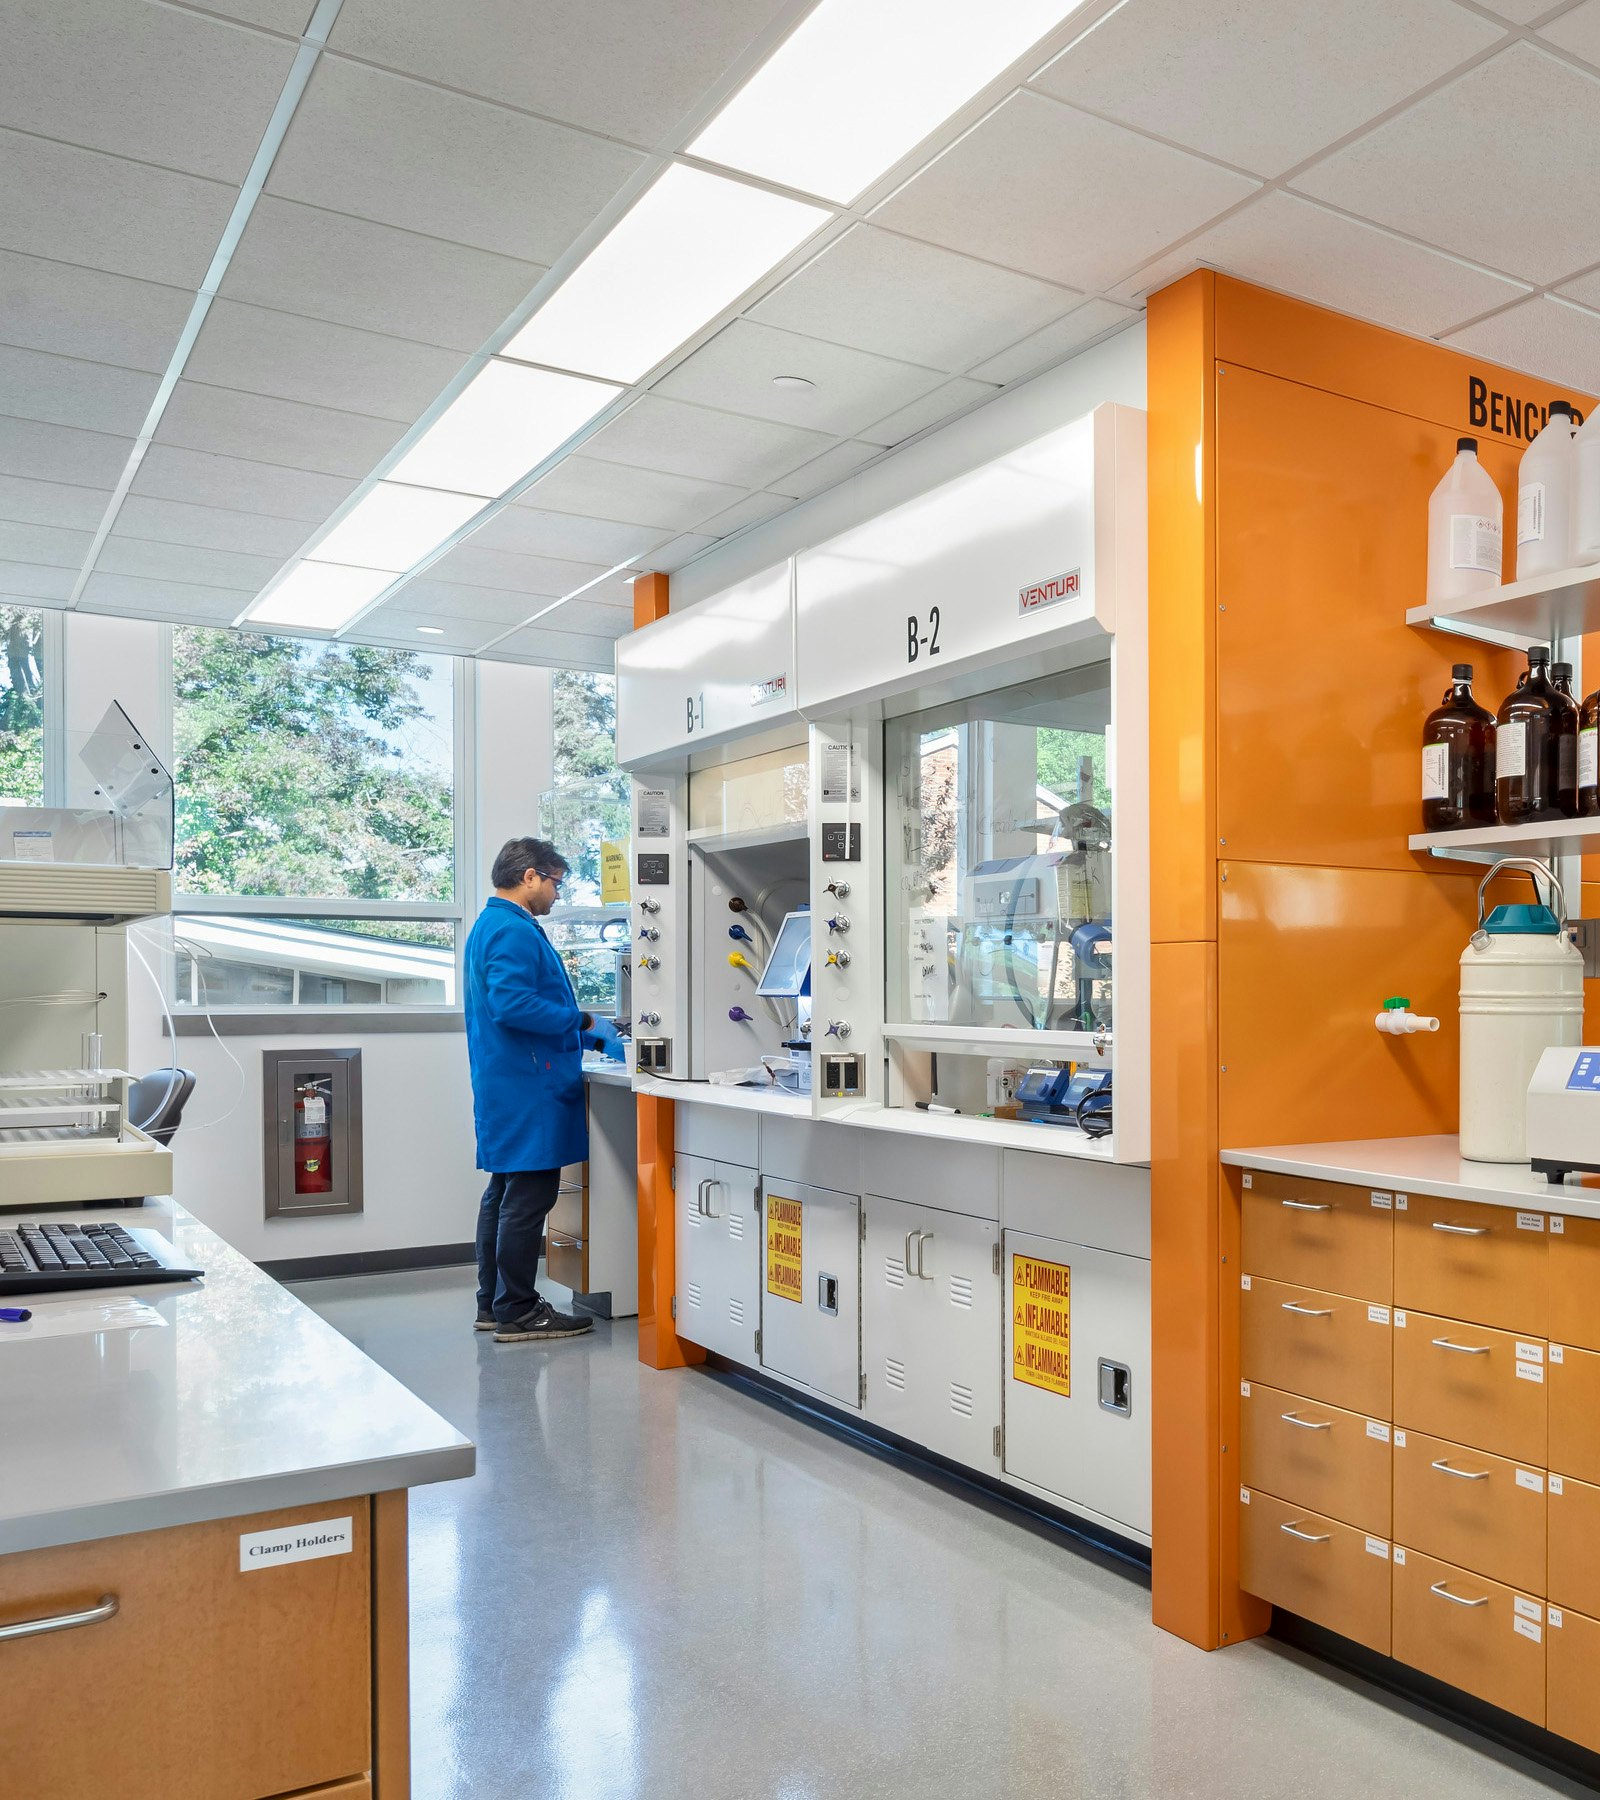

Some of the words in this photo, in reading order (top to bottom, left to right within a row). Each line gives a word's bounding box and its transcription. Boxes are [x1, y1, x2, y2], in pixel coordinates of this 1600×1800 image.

[1020, 574, 1079, 608] VENTURI
[908, 606, 940, 663] B-2
[754, 677, 785, 699] NTURI
[687, 691, 704, 733] B-1
[775, 1201, 800, 1226] FLAMMABLE
[1025, 1263, 1068, 1297] FLAMMABLE
[1030, 1291, 1040, 1299] KEEP
[1041, 1293, 1051, 1302] FIRE
[1051, 1296, 1064, 1305] AWAY
[1025, 1302, 1068, 1339] INFLAMABLE
[1025, 1342, 1068, 1380] INFLAMMABLE
[249, 1543, 292, 1557] Clamp
[296, 1534, 345, 1548] Holders
[1550, 1613, 1561, 1621] B-12
